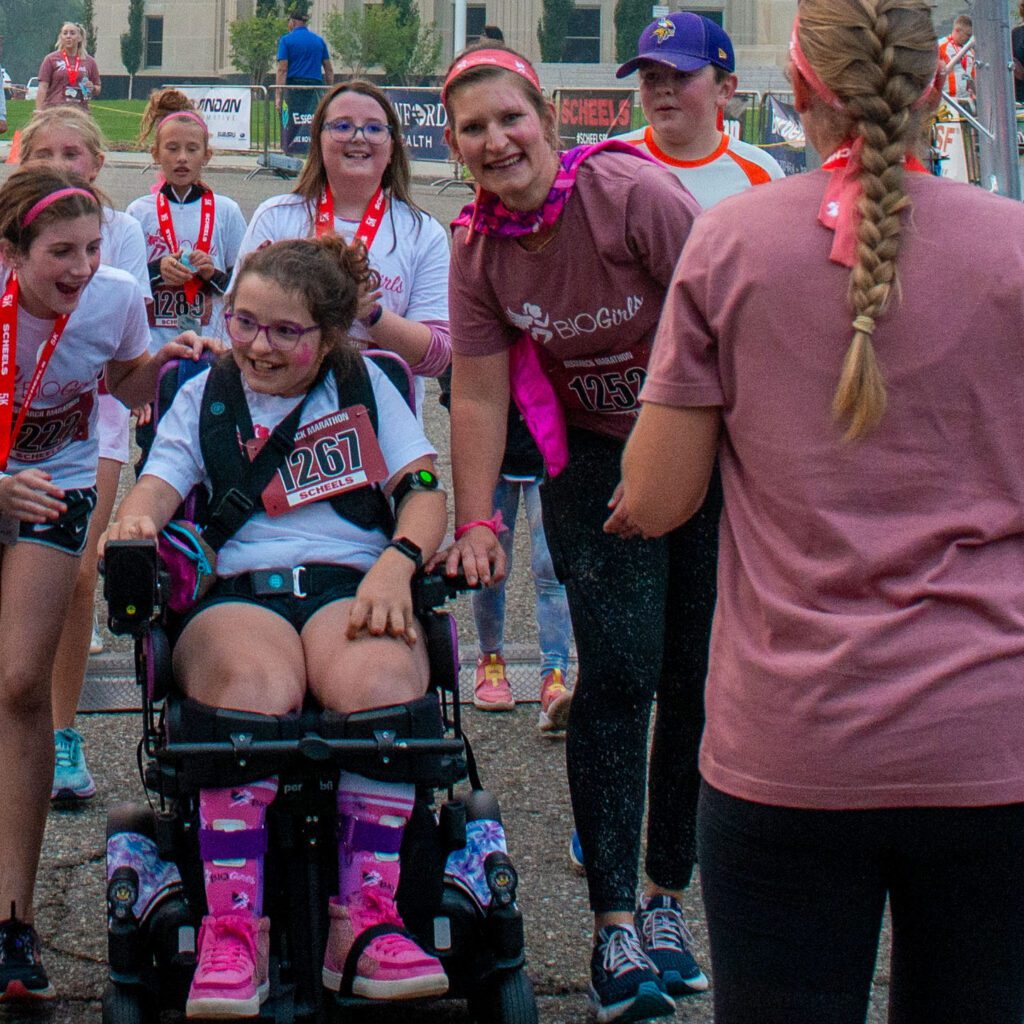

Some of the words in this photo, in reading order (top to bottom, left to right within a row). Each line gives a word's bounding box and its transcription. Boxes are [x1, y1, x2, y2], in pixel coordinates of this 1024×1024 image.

[561, 97, 631, 126] SCHEELS
[2, 294, 14, 308] 5K
[153, 290, 205, 316] 1289
[553, 295, 644, 340] BIOGirls
[0, 323, 10, 376] SCHEELS
[306, 412, 349, 435] MARATHON
[276, 427, 363, 494] 1267
[299, 476, 354, 500] SCHEELS
